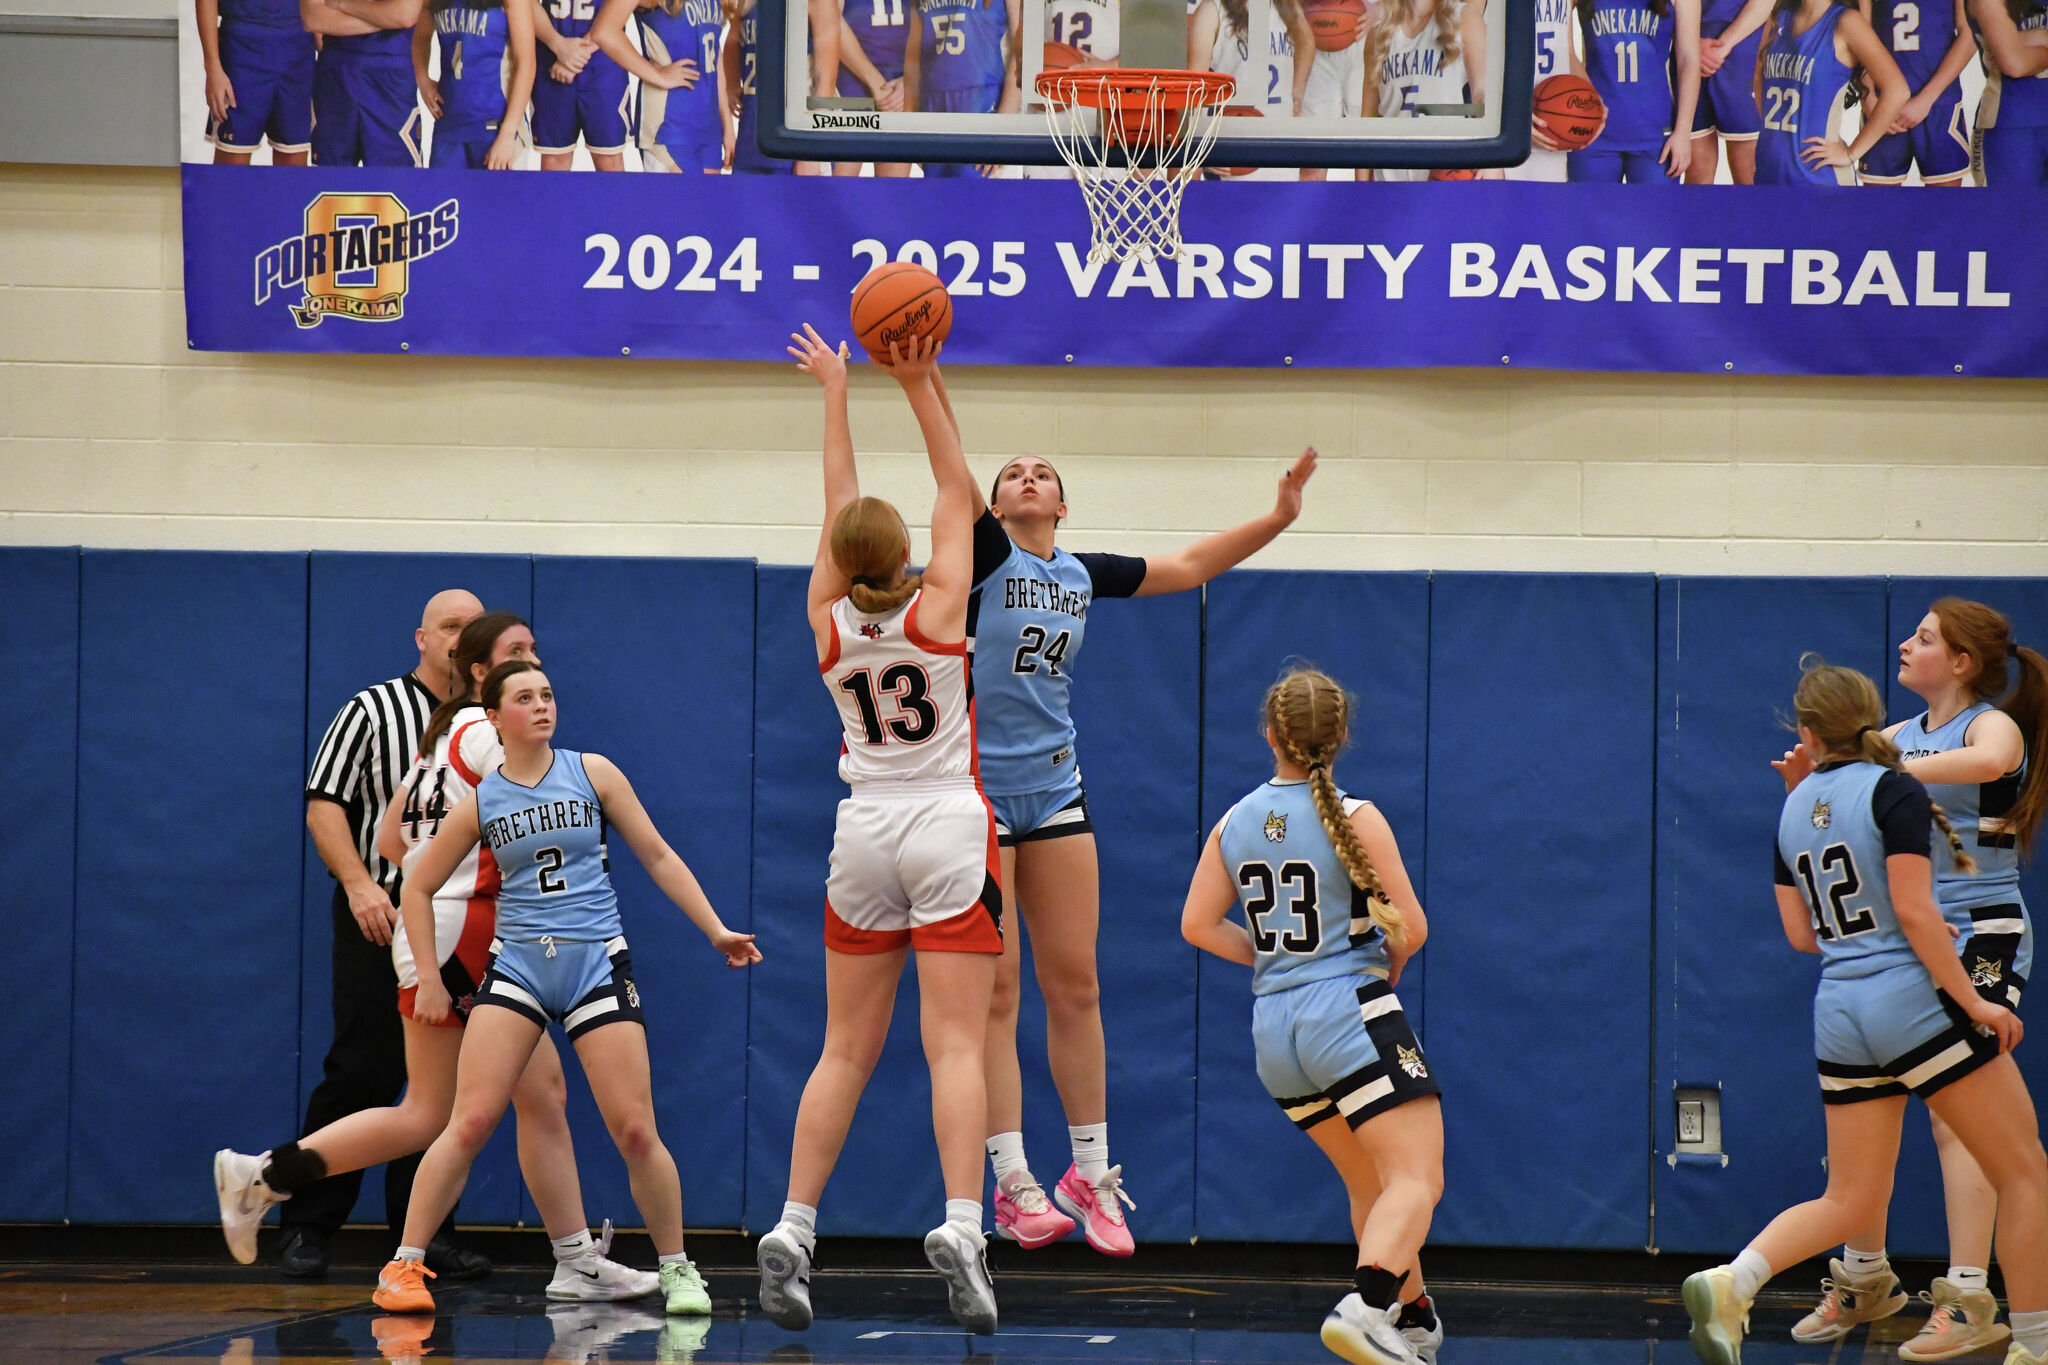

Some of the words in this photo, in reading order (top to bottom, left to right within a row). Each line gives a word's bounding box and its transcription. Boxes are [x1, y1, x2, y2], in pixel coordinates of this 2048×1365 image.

[931, 12, 966, 55] 55
[1052, 11, 1093, 53] 12
[1892, 1, 1920, 52] 2
[1381, 49, 1445, 84] ONEKAMA
[1536, 31, 1555, 74] 5
[1614, 40, 1639, 83] 11
[812, 113, 880, 130] SPALDING
[1764, 86, 1801, 133] 22
[255, 198, 459, 306] PORTAGERS
[583, 233, 763, 292] 2024
[1055, 241, 1424, 299] VARSITY
[1449, 242, 2010, 307] BASKETBALL
[308, 297, 398, 316] ONEKAMA
[880, 299, 932, 346] Rawlings
[1012, 623, 1072, 677] 24
[838, 660, 939, 746] 13
[400, 763, 453, 842] 44
[487, 799, 595, 850] BRETHREN
[534, 845, 568, 896] 2
[1796, 840, 1879, 941] 12
[1237, 859, 1322, 955] 23
